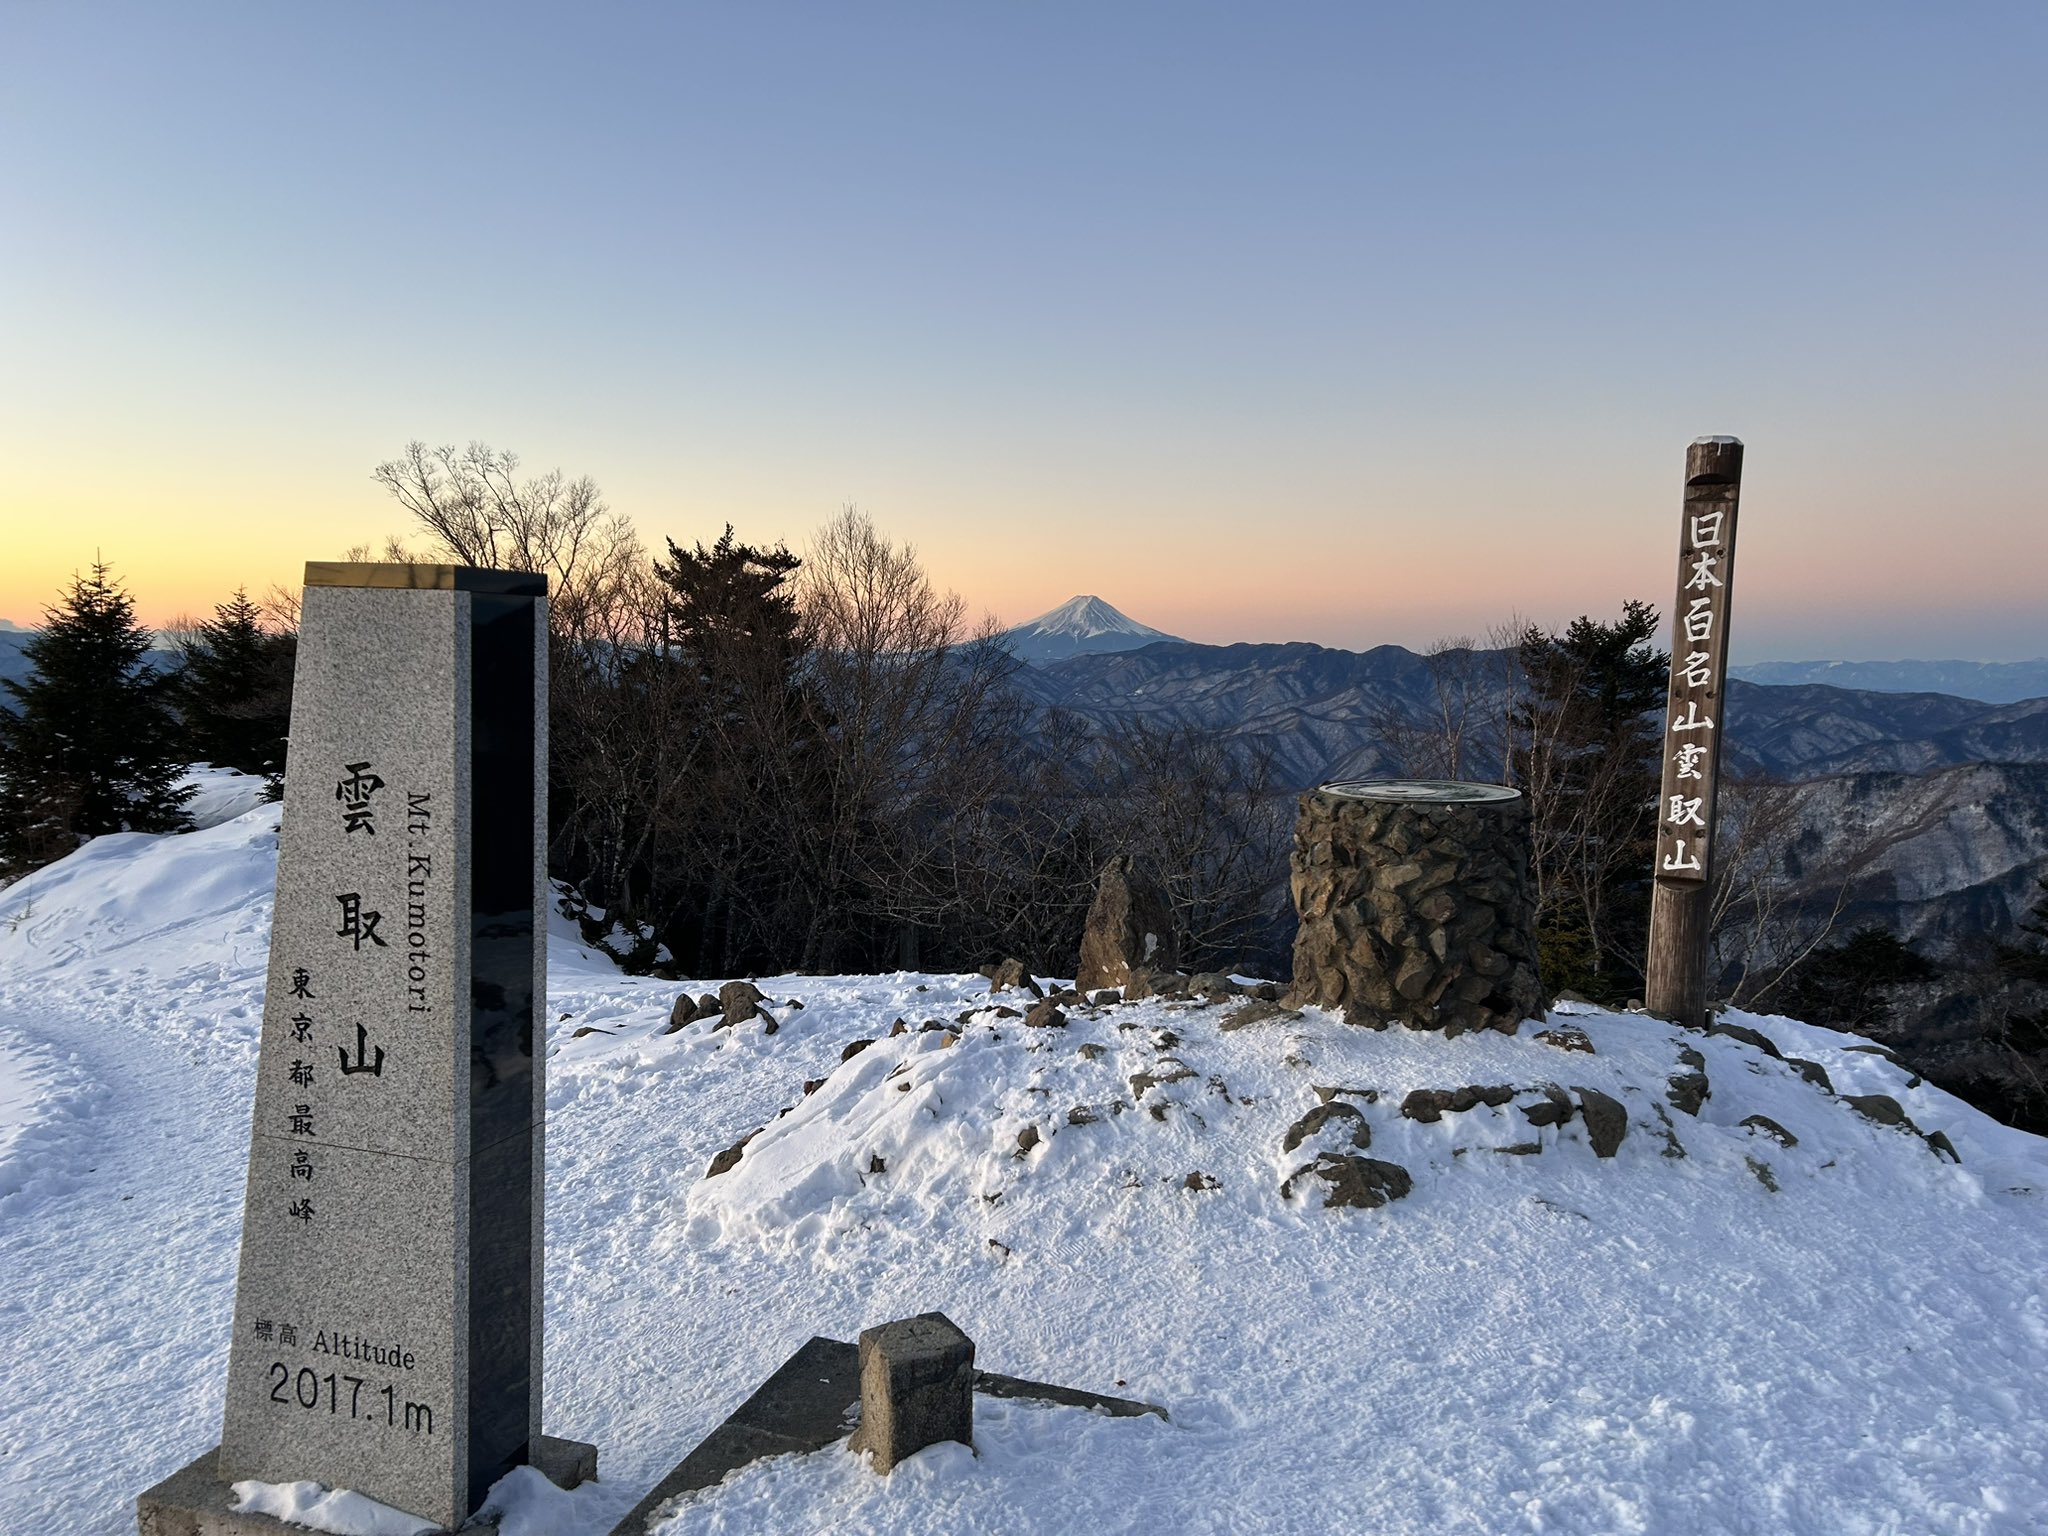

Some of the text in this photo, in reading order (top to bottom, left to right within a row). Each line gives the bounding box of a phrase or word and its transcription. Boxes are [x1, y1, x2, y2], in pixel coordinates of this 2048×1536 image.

[335, 762, 388, 1077] 雲取山
[288, 967, 315, 1225] 東京都最高峰
[254, 1317, 415, 1370] 標高 Altitude
[270, 1362, 432, 1435] 2017.1m
